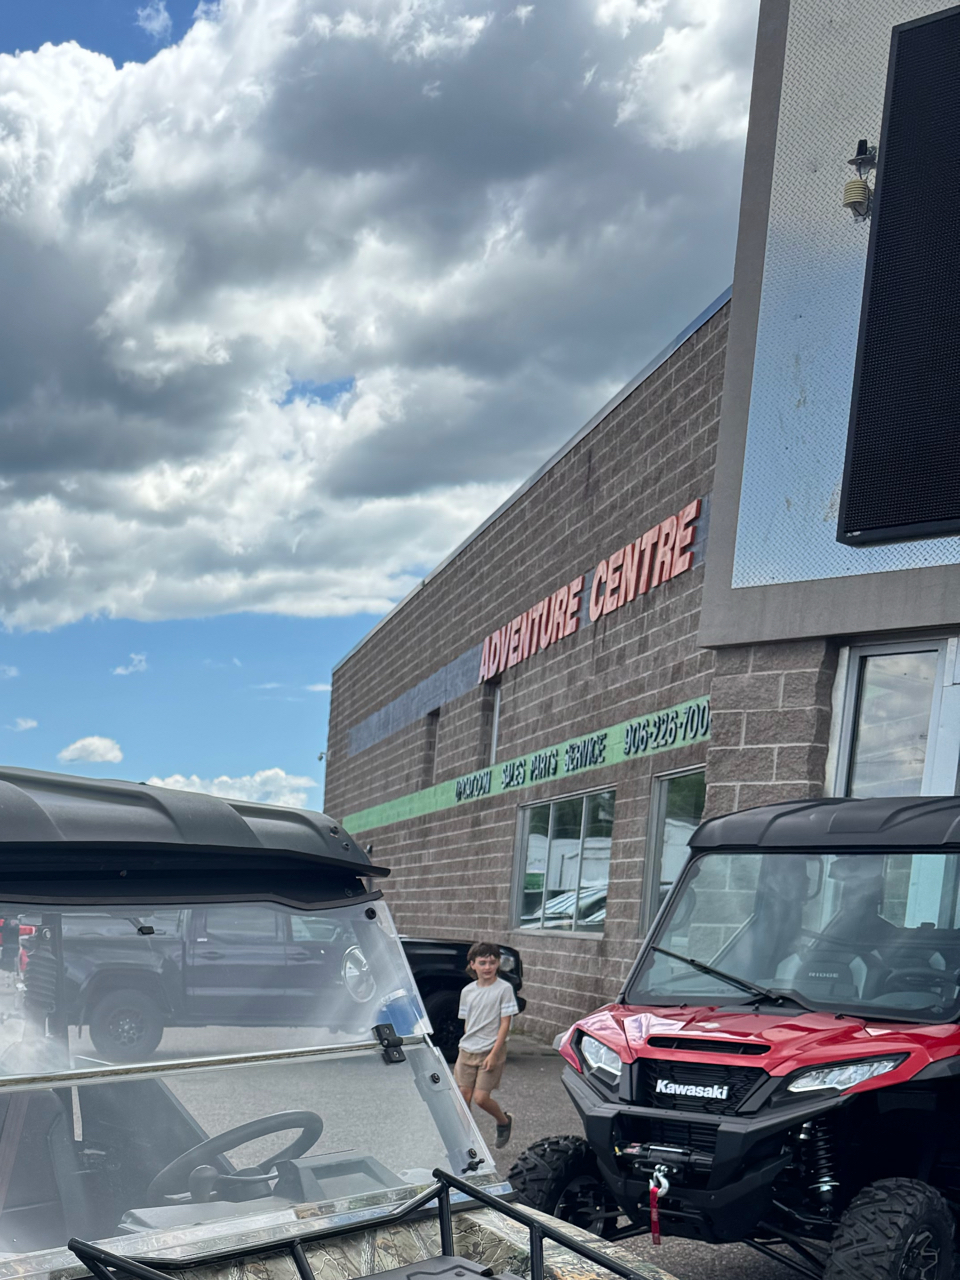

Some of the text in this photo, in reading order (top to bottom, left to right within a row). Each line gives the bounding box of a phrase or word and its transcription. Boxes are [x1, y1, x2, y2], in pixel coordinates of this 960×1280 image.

[478, 498, 701, 684] ADVENTURE CENTRE
[501, 759, 526, 790] SALES
[530, 749, 558, 781] PARTS
[565, 734, 608, 773] SERVICE
[624, 700, 713, 756] 906-226-700
[655, 1079, 729, 1100] Kawasaki
